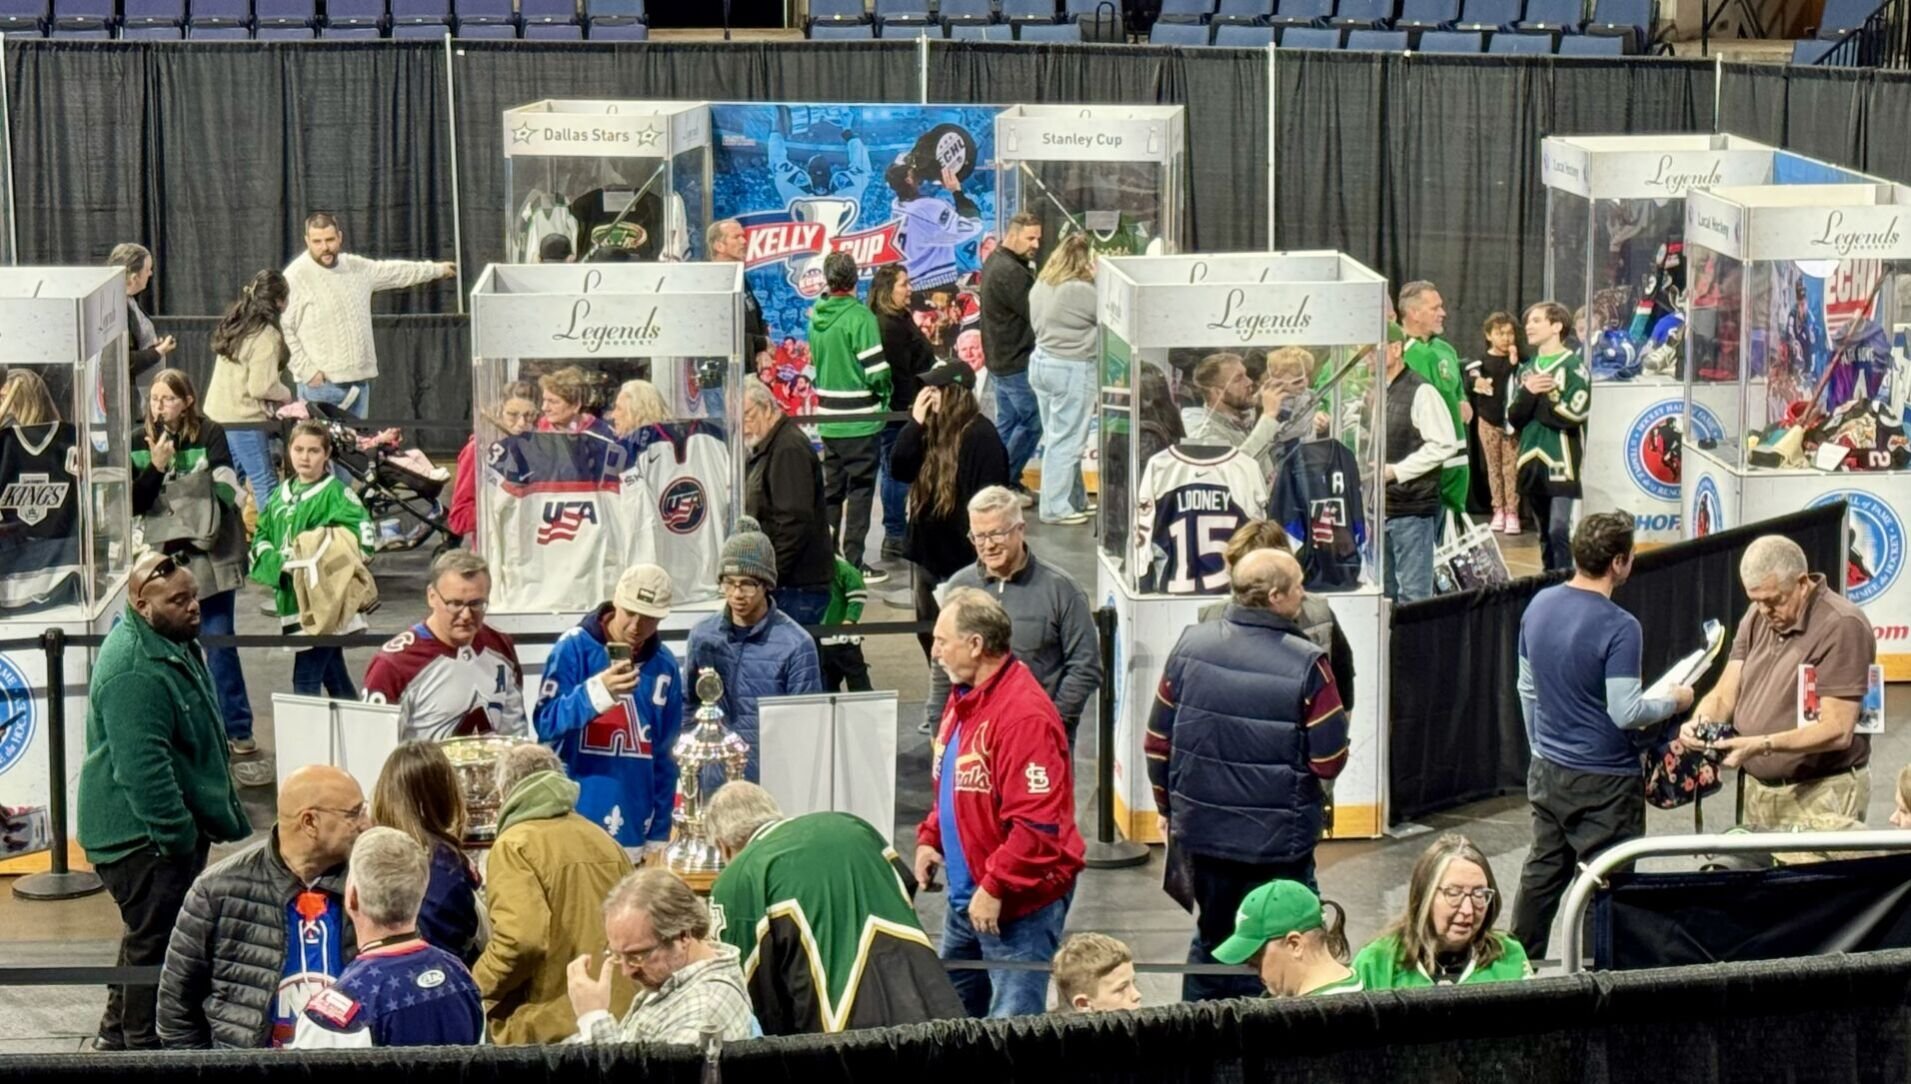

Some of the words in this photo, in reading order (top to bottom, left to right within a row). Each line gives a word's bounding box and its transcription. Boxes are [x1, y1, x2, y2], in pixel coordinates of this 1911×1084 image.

[544, 128, 588, 142] Dallas
[592, 128, 630, 142] Stars
[1042, 132, 1093, 147] Stanley
[1096, 133, 1122, 147] Cup
[1644, 154, 1722, 194] Legends
[745, 225, 821, 264] KELLY
[838, 233, 886, 265] CUP
[1810, 210, 1900, 256] Legends
[552, 299, 661, 353] Legends
[1207, 288, 1312, 342] Legends
[5, 485, 65, 507] KINGS
[1332, 471, 1344, 494] A
[1177, 489, 1232, 513] LOONEY
[1870, 503, 1894, 527] FAME
[540, 501, 598, 541] USA
[1168, 516, 1238, 593] 15
[652, 674, 671, 706] C
[10, 696, 28, 744] HOCEY
